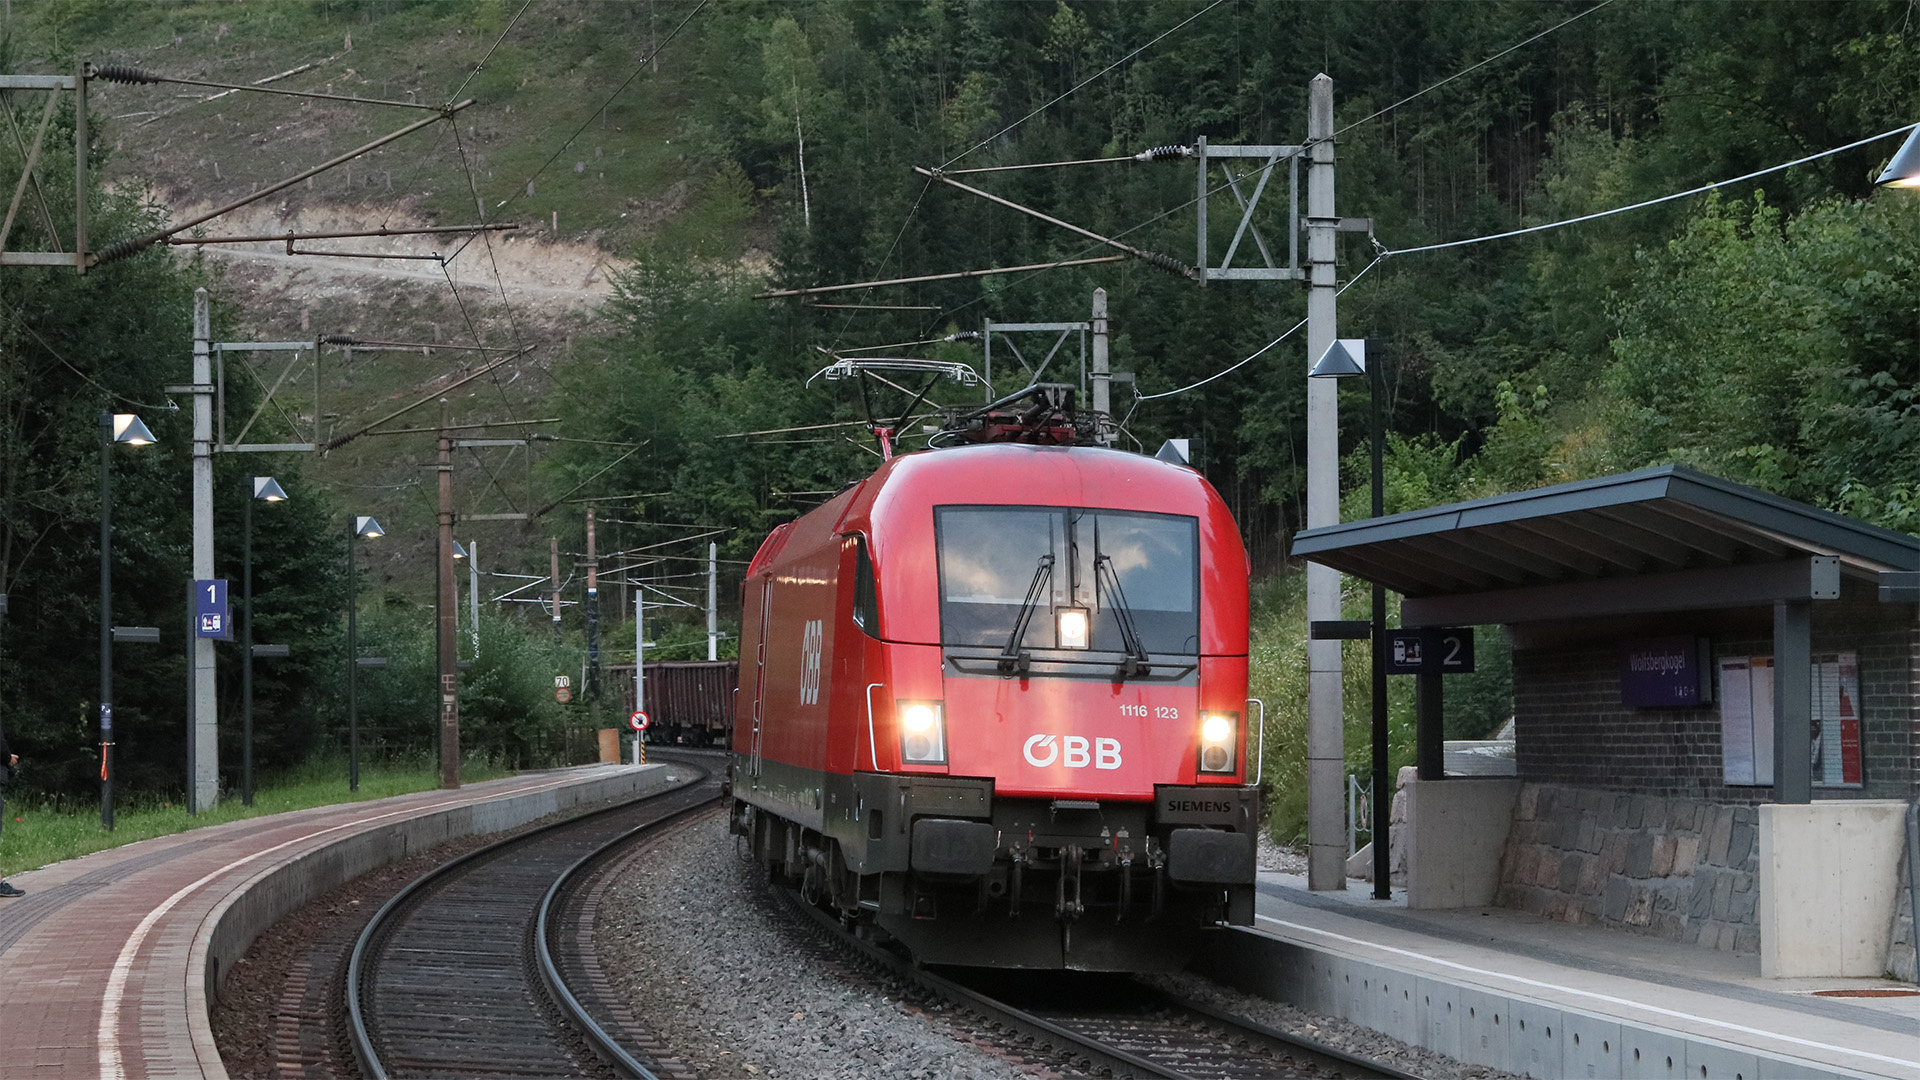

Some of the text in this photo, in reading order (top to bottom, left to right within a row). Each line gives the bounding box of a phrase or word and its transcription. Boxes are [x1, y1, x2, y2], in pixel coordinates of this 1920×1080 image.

[207, 584, 216, 604] 1
[800, 619, 823, 706] ÖBB
[1443, 636, 1462, 666] 2
[1629, 649, 1686, 676] Wolfsbergkogel
[556, 677, 568, 687] 70
[1119, 704, 1179, 720] 1116 123
[1022, 734, 1123, 770] ÖBB
[1168, 800, 1231, 813] SIEMENS
